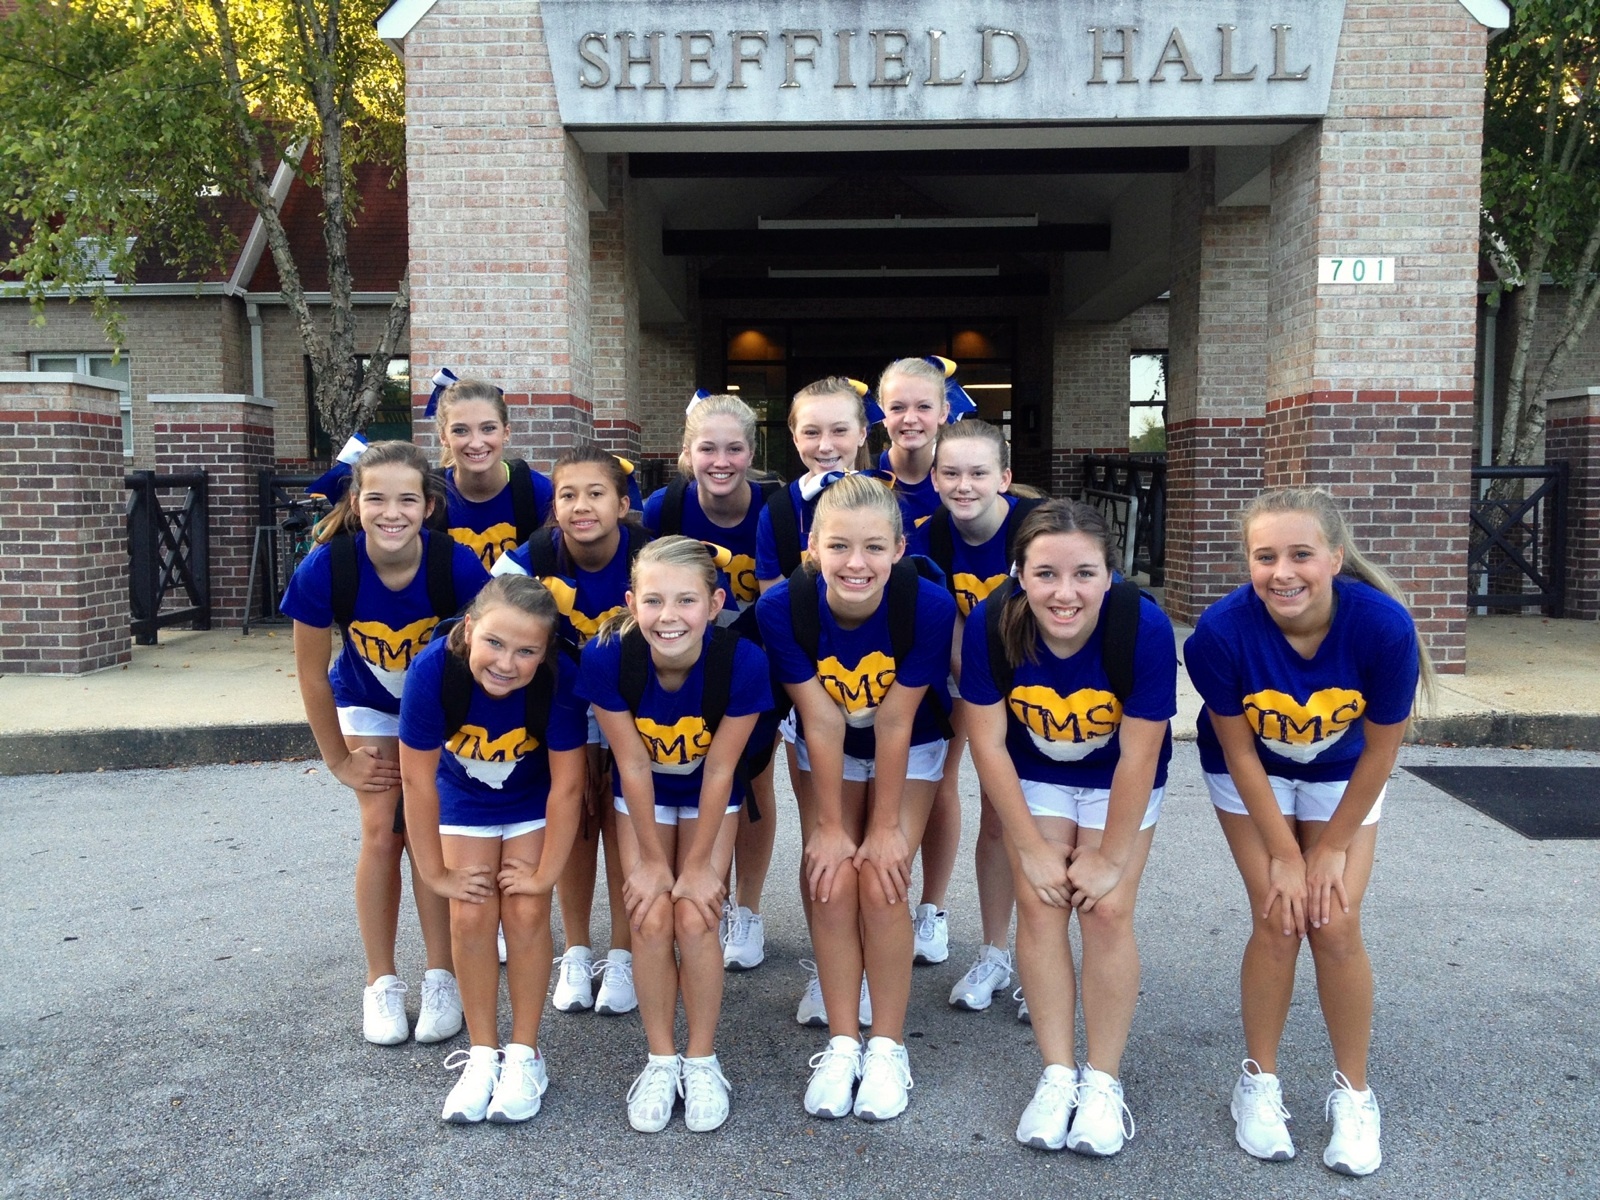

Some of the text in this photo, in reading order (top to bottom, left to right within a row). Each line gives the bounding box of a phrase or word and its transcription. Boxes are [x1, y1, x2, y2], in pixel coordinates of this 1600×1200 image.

[578, 23, 1312, 90] SHEFFIELD HALL
[1331, 259, 1383, 281] 701
[1010, 698, 1114, 743] TMS
[1245, 699, 1358, 744] TMS
